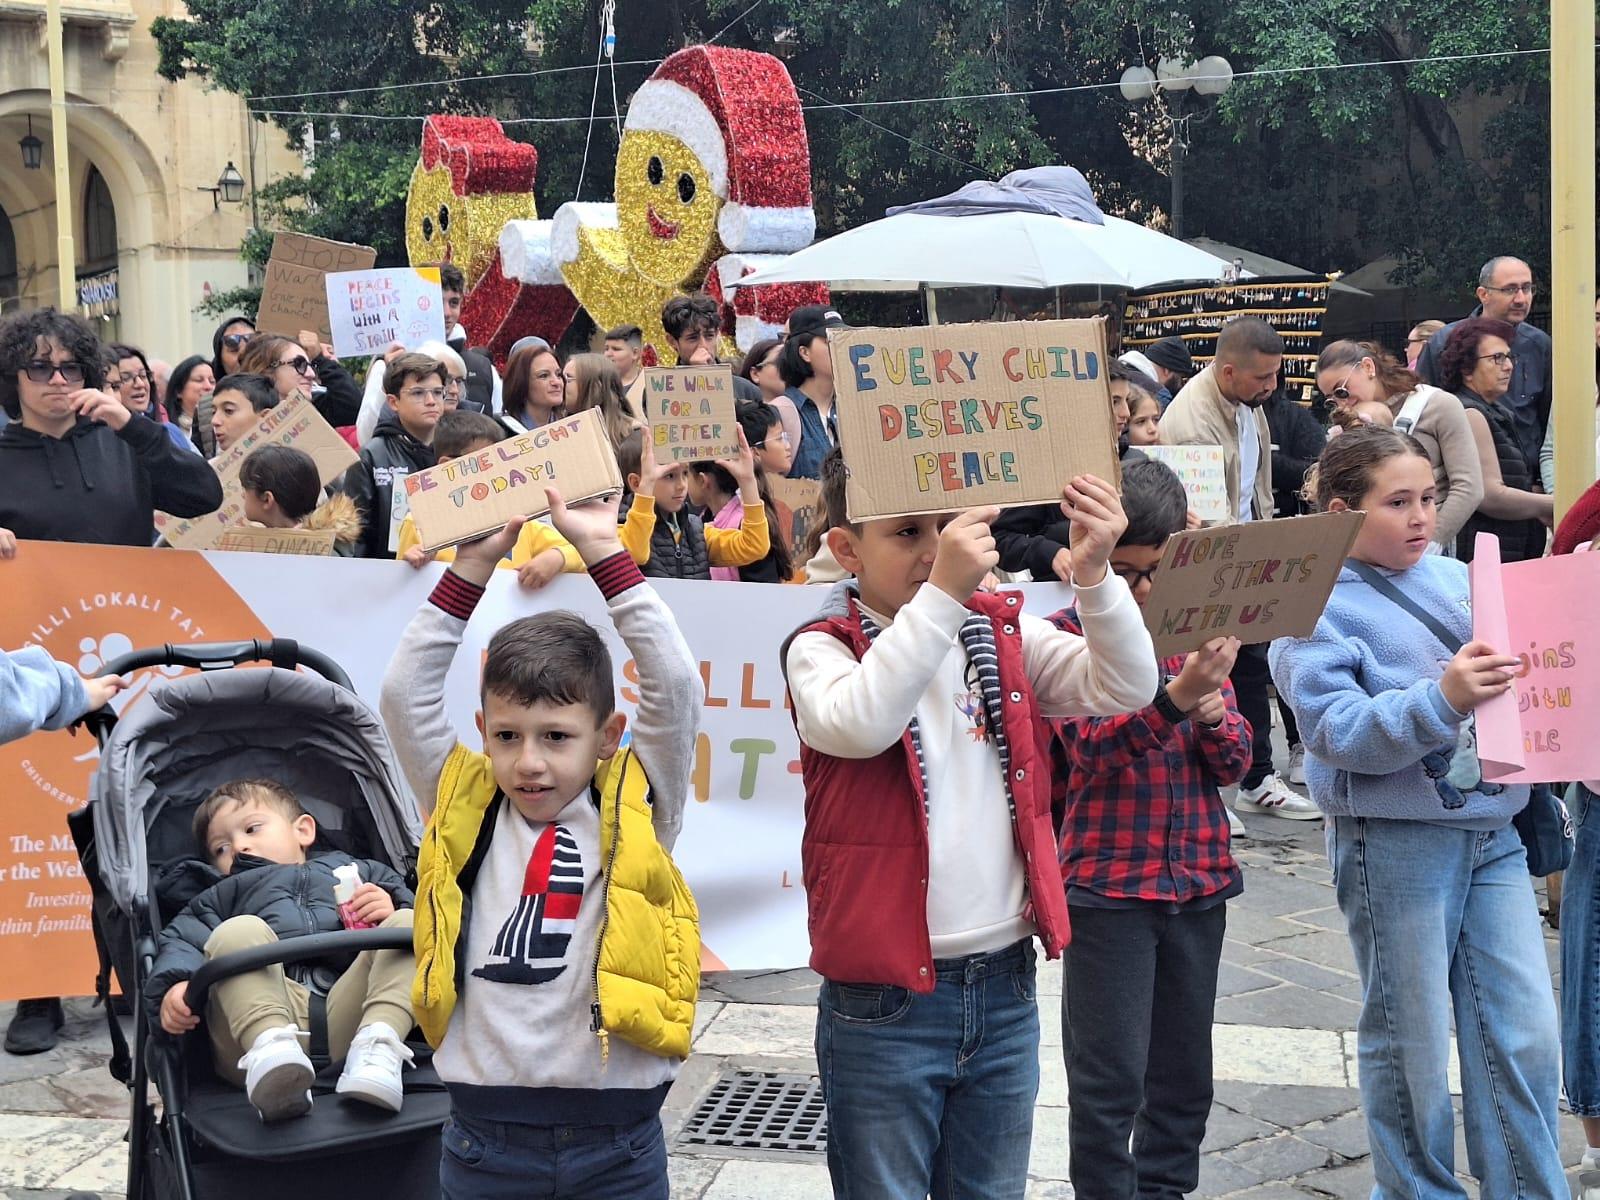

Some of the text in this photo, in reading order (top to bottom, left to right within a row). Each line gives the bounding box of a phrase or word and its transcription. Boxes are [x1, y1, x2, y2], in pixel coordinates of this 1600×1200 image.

[650, 375, 724, 392] WE WALK
[849, 344, 1099, 392] EVERY CHILD
[661, 398, 711, 416] FOR A
[878, 396, 1043, 441] DESERVES
[654, 423, 722, 446] BETTER
[404, 470, 438, 496] BE
[441, 452, 493, 481] THE
[497, 420, 581, 462] LIGHT
[914, 451, 1018, 492] PEACE
[448, 460, 556, 508] TODAY!
[1170, 533, 1240, 570] HOPE
[1209, 553, 1319, 598] STARTS
[80, 591, 161, 613] LOKALI
[169, 606, 205, 640] TAT
[1158, 599, 1280, 636] WITH US
[9, 834, 45, 853] The
[11, 862, 41, 880] the
[0, 918, 32, 935] thin
